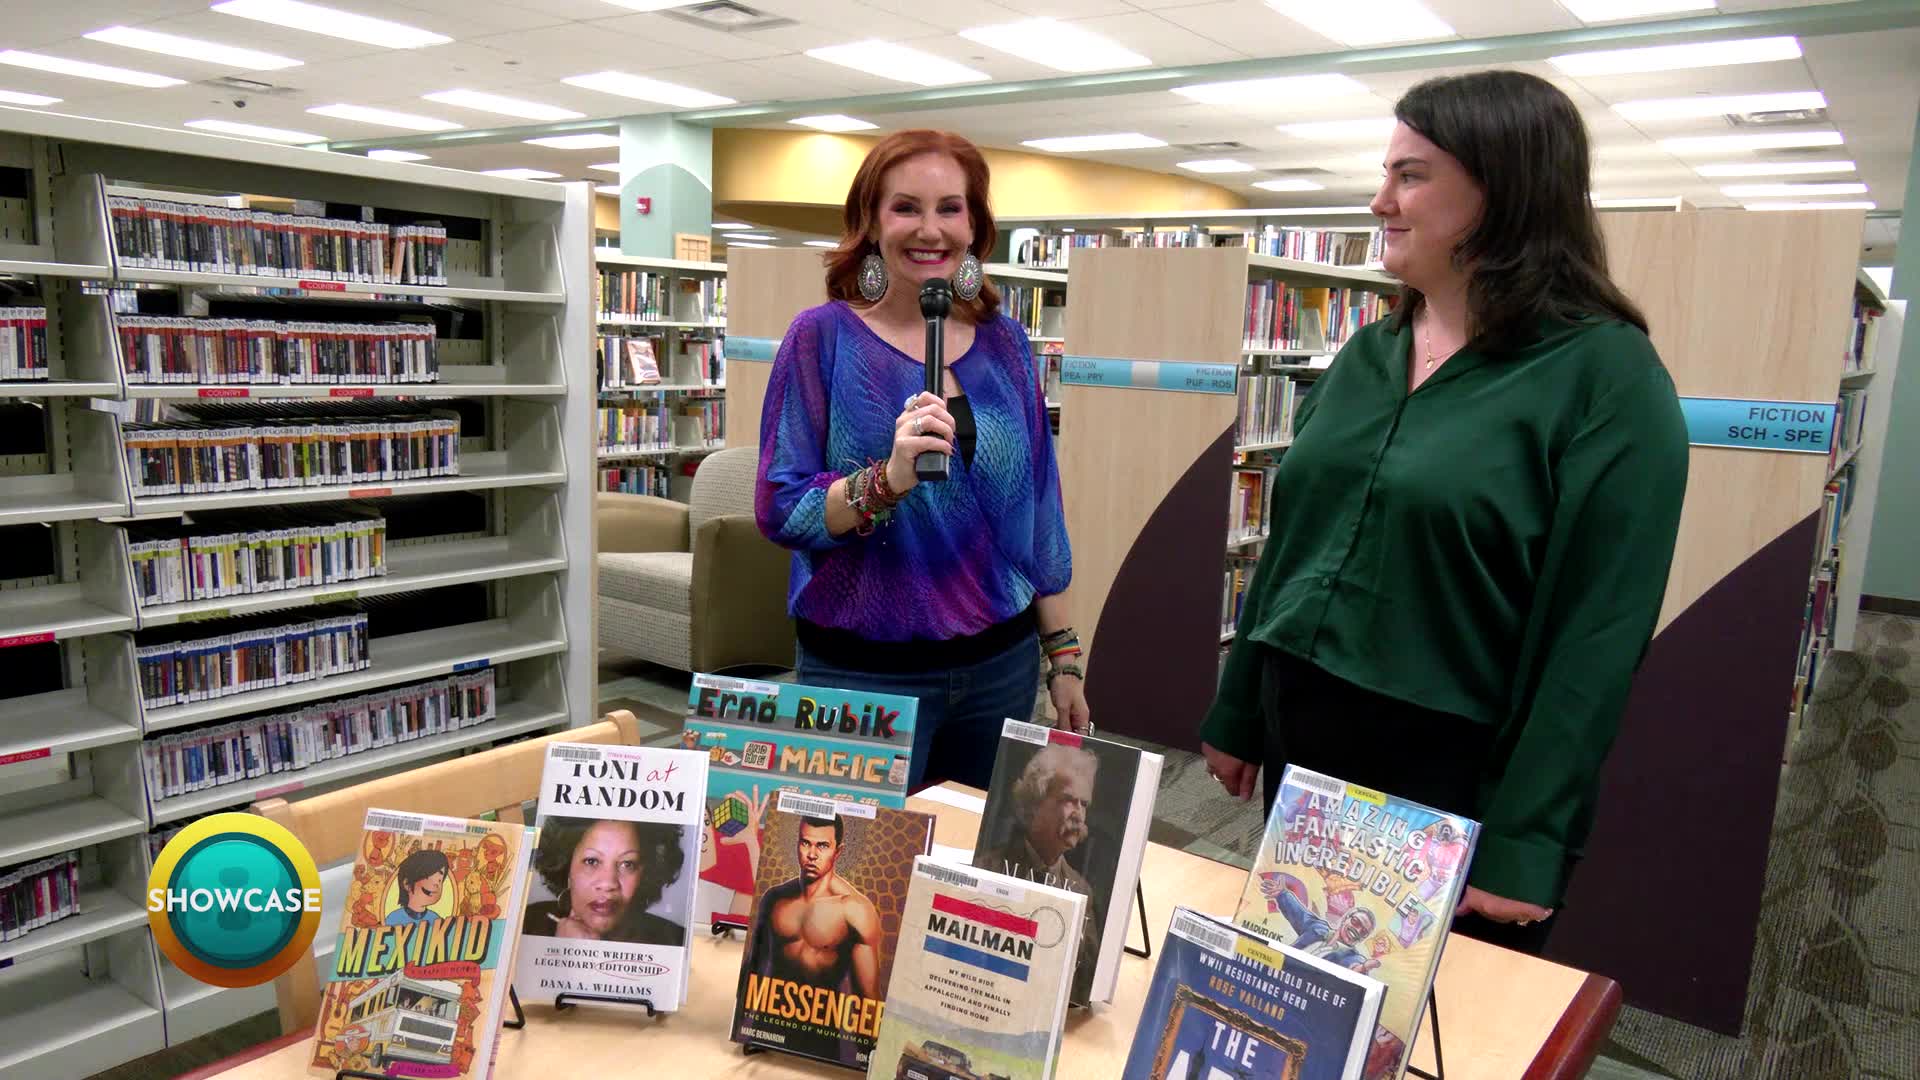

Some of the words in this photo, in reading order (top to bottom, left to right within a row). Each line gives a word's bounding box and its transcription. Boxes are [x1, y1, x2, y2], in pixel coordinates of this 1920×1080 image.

[306, 282, 338, 290] COUNTRY
[1064, 360, 1097, 369] FICTION
[1196, 367, 1233, 377] FICTION
[1064, 371, 1081, 380] PEA
[1087, 373, 1104, 382] PRY
[1186, 378, 1204, 387] PUF
[206, 389, 242, 397] COUNTRY
[336, 389, 368, 397] COUNTRY
[1749, 407, 1825, 423] FICTION
[1728, 426, 1767, 440] SCH
[1784, 429, 1824, 443] SPE
[795, 697, 900, 739] Rubik
[646, 760, 679, 783] at
[780, 745, 888, 784] MAGIC
[554, 783, 685, 812] RANDOM
[1308, 791, 1428, 850] AMAZING
[1294, 814, 1426, 882] FANTASTIC
[1275, 840, 1419, 918] INCREDIBLE
[337, 915, 491, 977] MEXIKID
[927, 913, 1034, 961] MAILMAN
[535, 957, 595, 970] LEGENDARY
[599, 963, 663, 975] EDITORSHIP
[563, 948, 599, 958] ICONIC
[603, 951, 654, 962] WRITER'S
[1247, 947, 1274, 964] CENTRAL
[540, 979, 572, 990] DANA
[577, 982, 588, 991] A.
[593, 983, 653, 996] WILLIAMS
[929, 973, 969, 992] DELIVERING
[971, 985, 983, 995] THE
[984, 989, 1002, 1002] MAIL
[1003, 996, 1011, 1004] IN
[949, 968, 958, 976] MY
[960, 971, 977, 982] WILD
[978, 977, 995, 987] RIDE
[1199, 951, 1223, 971] WWII
[1224, 963, 1280, 998] RESISTANCE
[1282, 991, 1308, 1011] HERO
[924, 984, 966, 1003] APPALACHIA
[968, 997, 982, 1007] AND
[983, 1001, 1011, 1017] FINALLY
[1208, 975, 1235, 997] ROSE
[1238, 990, 1286, 1022] VALLAND
[1305, 981, 1330, 1001] TALE
[1332, 993, 1347, 1008] OF
[940, 1001, 968, 1016] FINDING
[969, 1010, 990, 1022] HOME
[740, 1026, 756, 1037] MARC
[756, 1029, 786, 1044] BERNARDIN
[744, 1012, 759, 1020] THE
[763, 1017, 797, 1029] LEGEND
[817, 1029, 869, 1046] MUHAMMAD
[1211, 1020, 1259, 1069] THE
